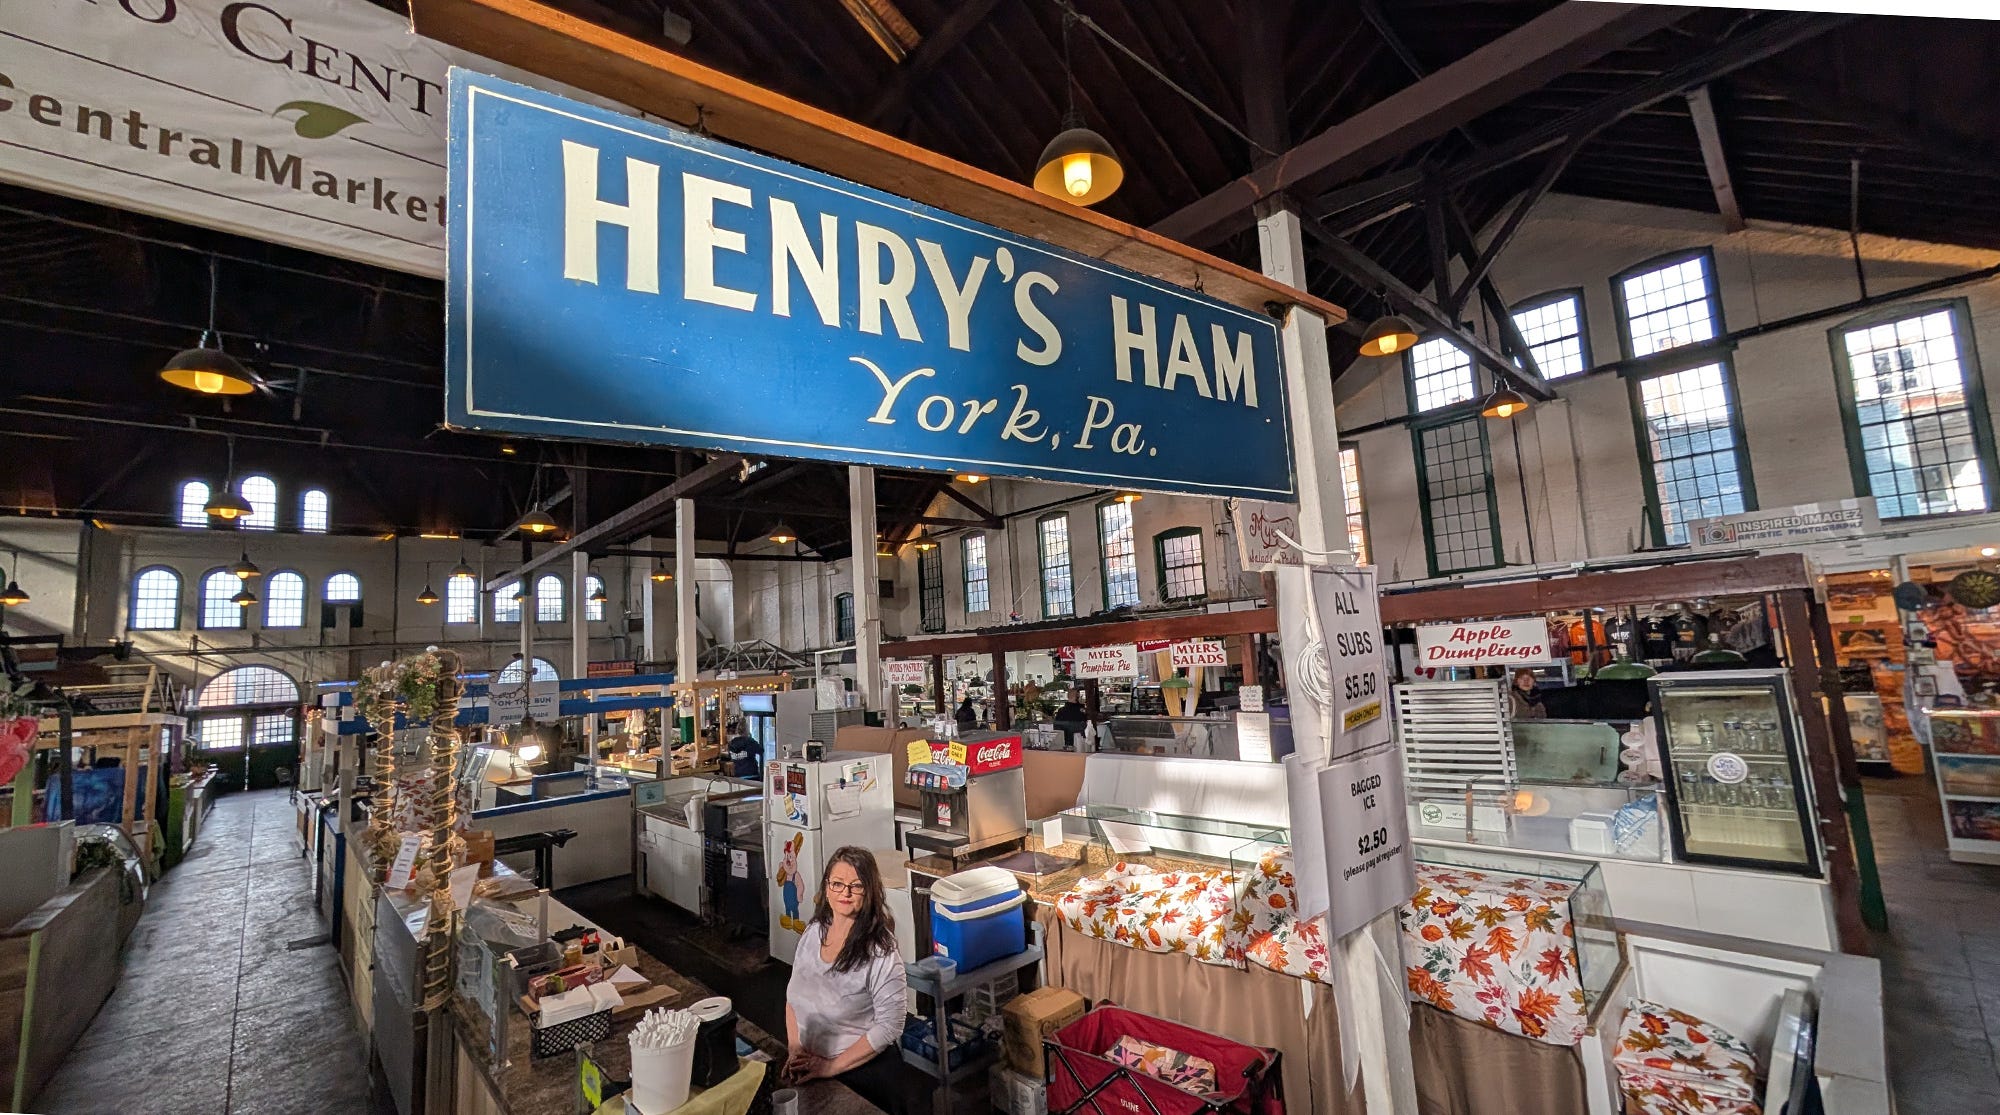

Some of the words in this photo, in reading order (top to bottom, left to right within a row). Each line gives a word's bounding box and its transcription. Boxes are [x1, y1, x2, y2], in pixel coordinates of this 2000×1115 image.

[562, 139, 1063, 367] HENRY'S
[1111, 294, 1259, 409] HAM
[848, 356, 1060, 452] York,
[1073, 395, 1158, 457] Pa.
[1737, 516, 1800, 533] INSPIRED
[1804, 508, 1862, 525] IMAGEZ
[1738, 530, 1784, 541] ARTISTIC
[1335, 591, 1360, 615] ALL
[1337, 631, 1373, 657] SUBS
[1449, 625, 1513, 644] Apple
[1088, 649, 1123, 660] MYERS
[1173, 654, 1225, 665] SALADS
[1176, 643, 1220, 655] MYERS
[1428, 643, 1543, 662] Dumplings
[1117, 659, 1131, 672] Pie
[1345, 671, 1376, 703] $5.50
[977, 743, 1011, 763] Coca-Cola
[1351, 774, 1382, 797] BAGGED
[1363, 795, 1376, 811] ICE
[1358, 827, 1388, 856] $2.50
[1343, 863, 1365, 881] (please
[1366, 858, 1376, 872] pay
[1381, 843, 1402, 861] register)
